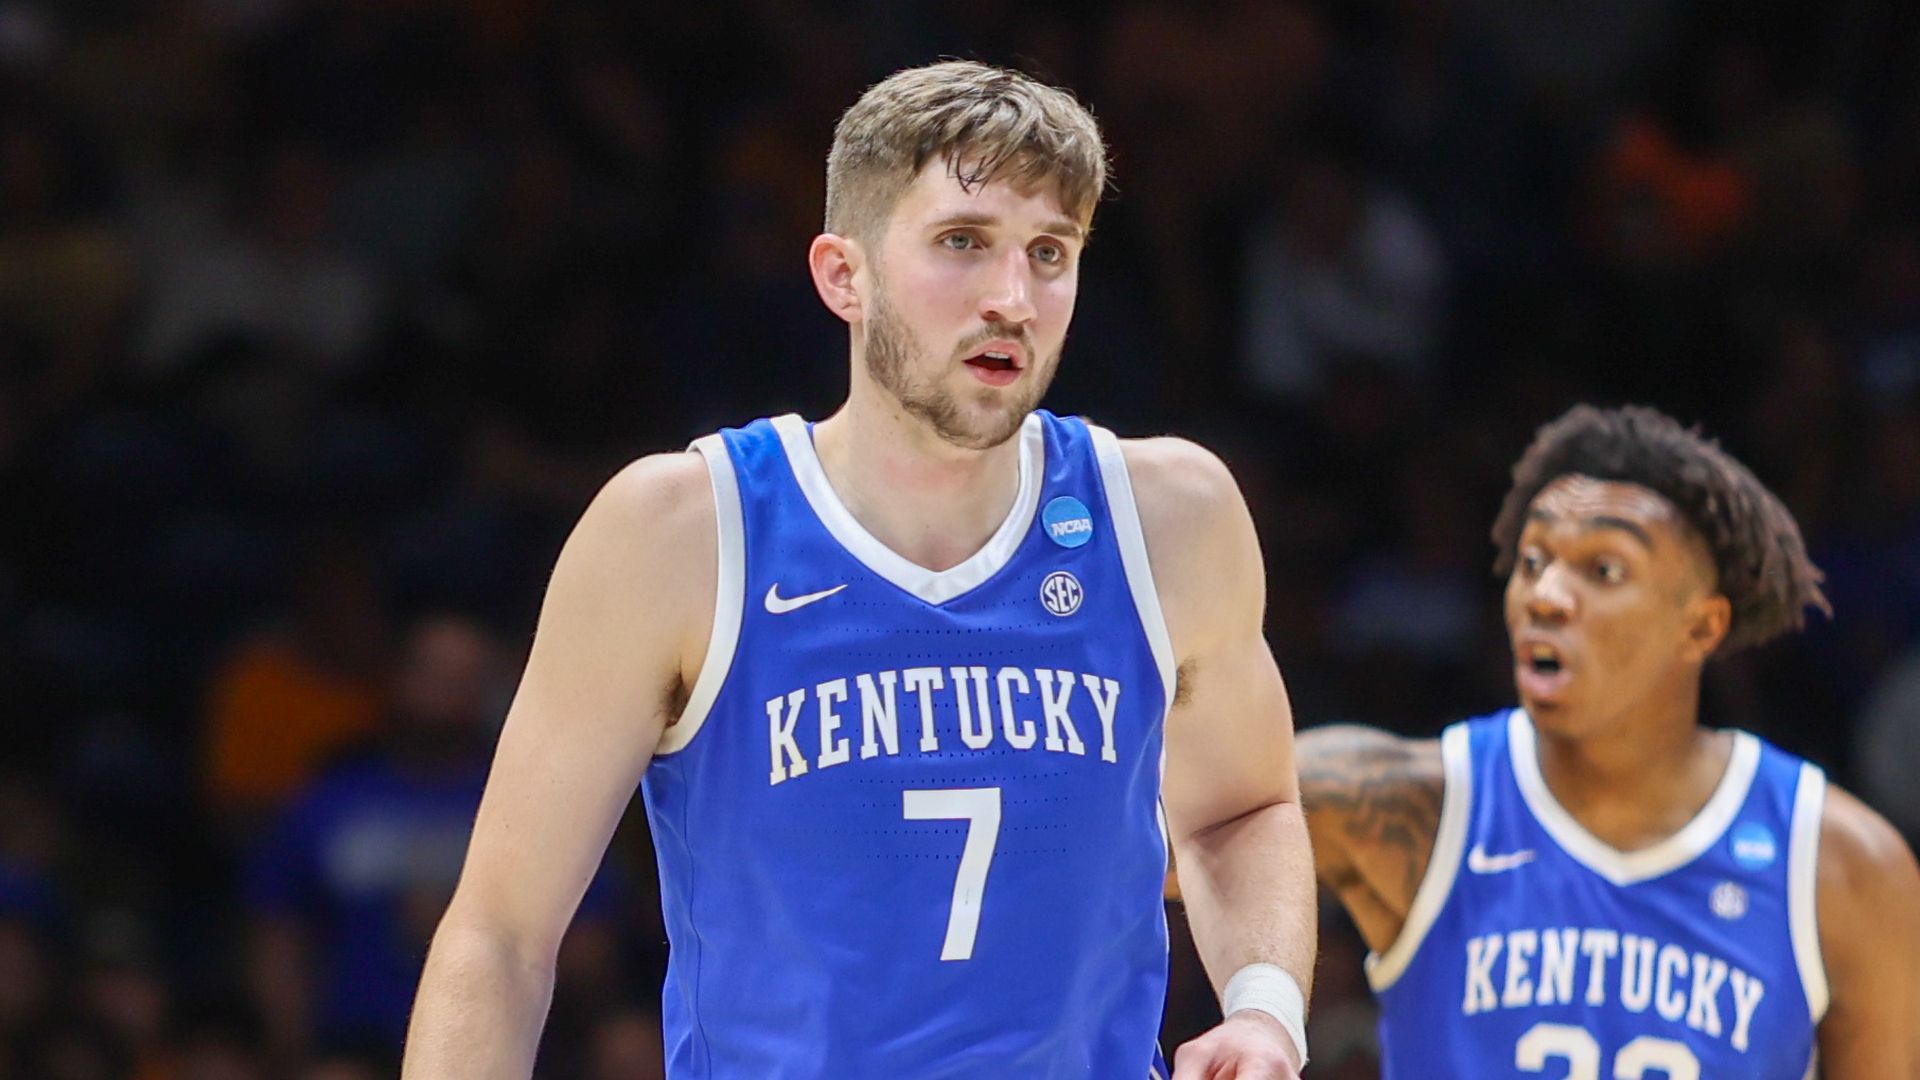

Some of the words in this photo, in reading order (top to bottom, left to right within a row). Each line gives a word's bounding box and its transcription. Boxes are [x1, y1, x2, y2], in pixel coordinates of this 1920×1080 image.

[1050, 518, 1092, 536] NCAA
[1044, 576, 1079, 612] SEC
[766, 666, 1121, 785] KENTUCKY
[903, 788, 1001, 961] 7
[1464, 928, 1764, 1052] KENTUCKY
